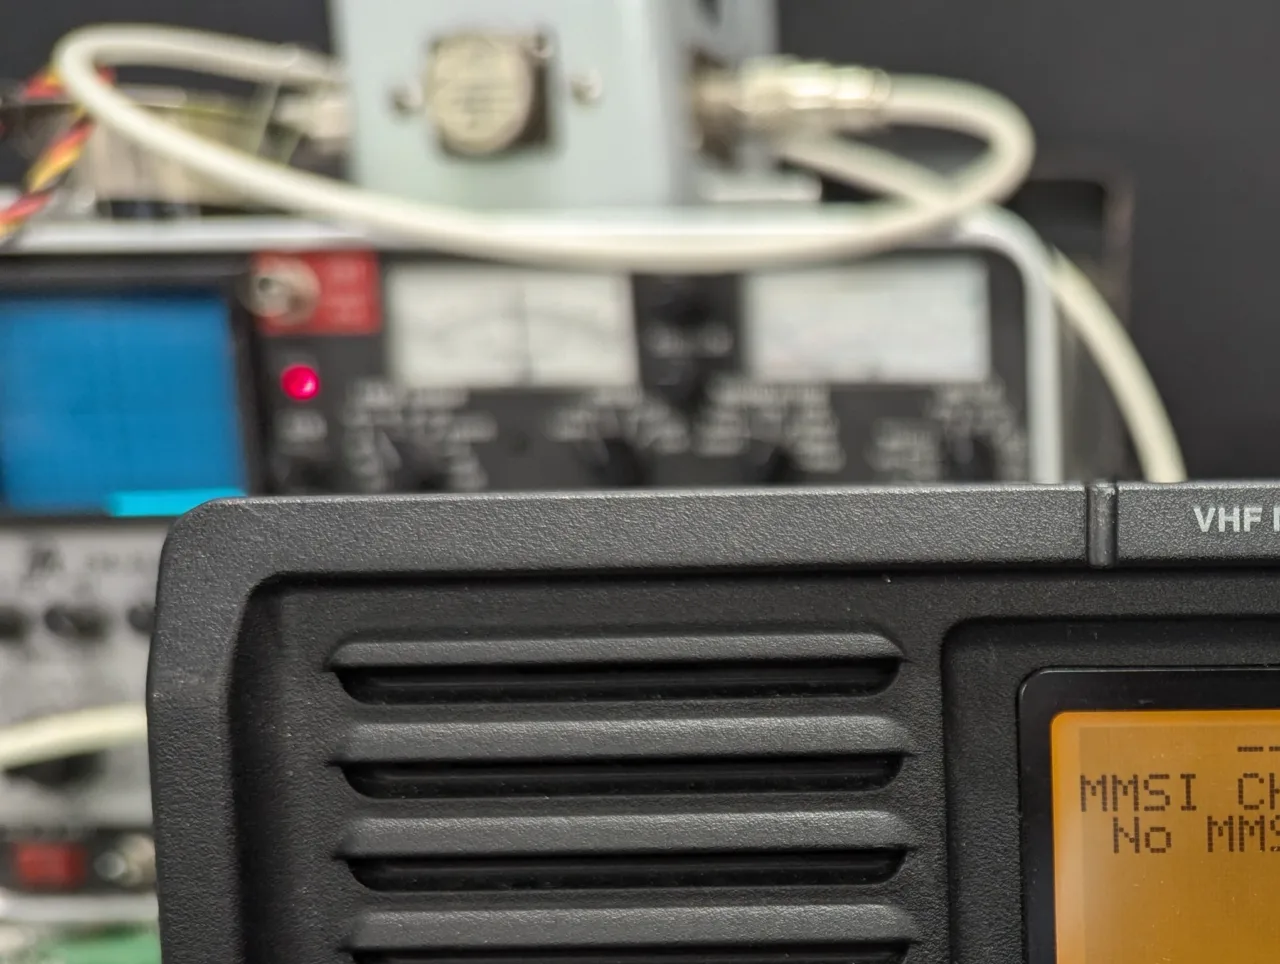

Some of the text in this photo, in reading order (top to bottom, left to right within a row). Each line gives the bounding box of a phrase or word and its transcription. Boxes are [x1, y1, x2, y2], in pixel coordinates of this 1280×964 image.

[1193, 506, 1263, 532] VHF
[1080, 773, 1197, 812] MMSI
[1112, 816, 1172, 854] No
